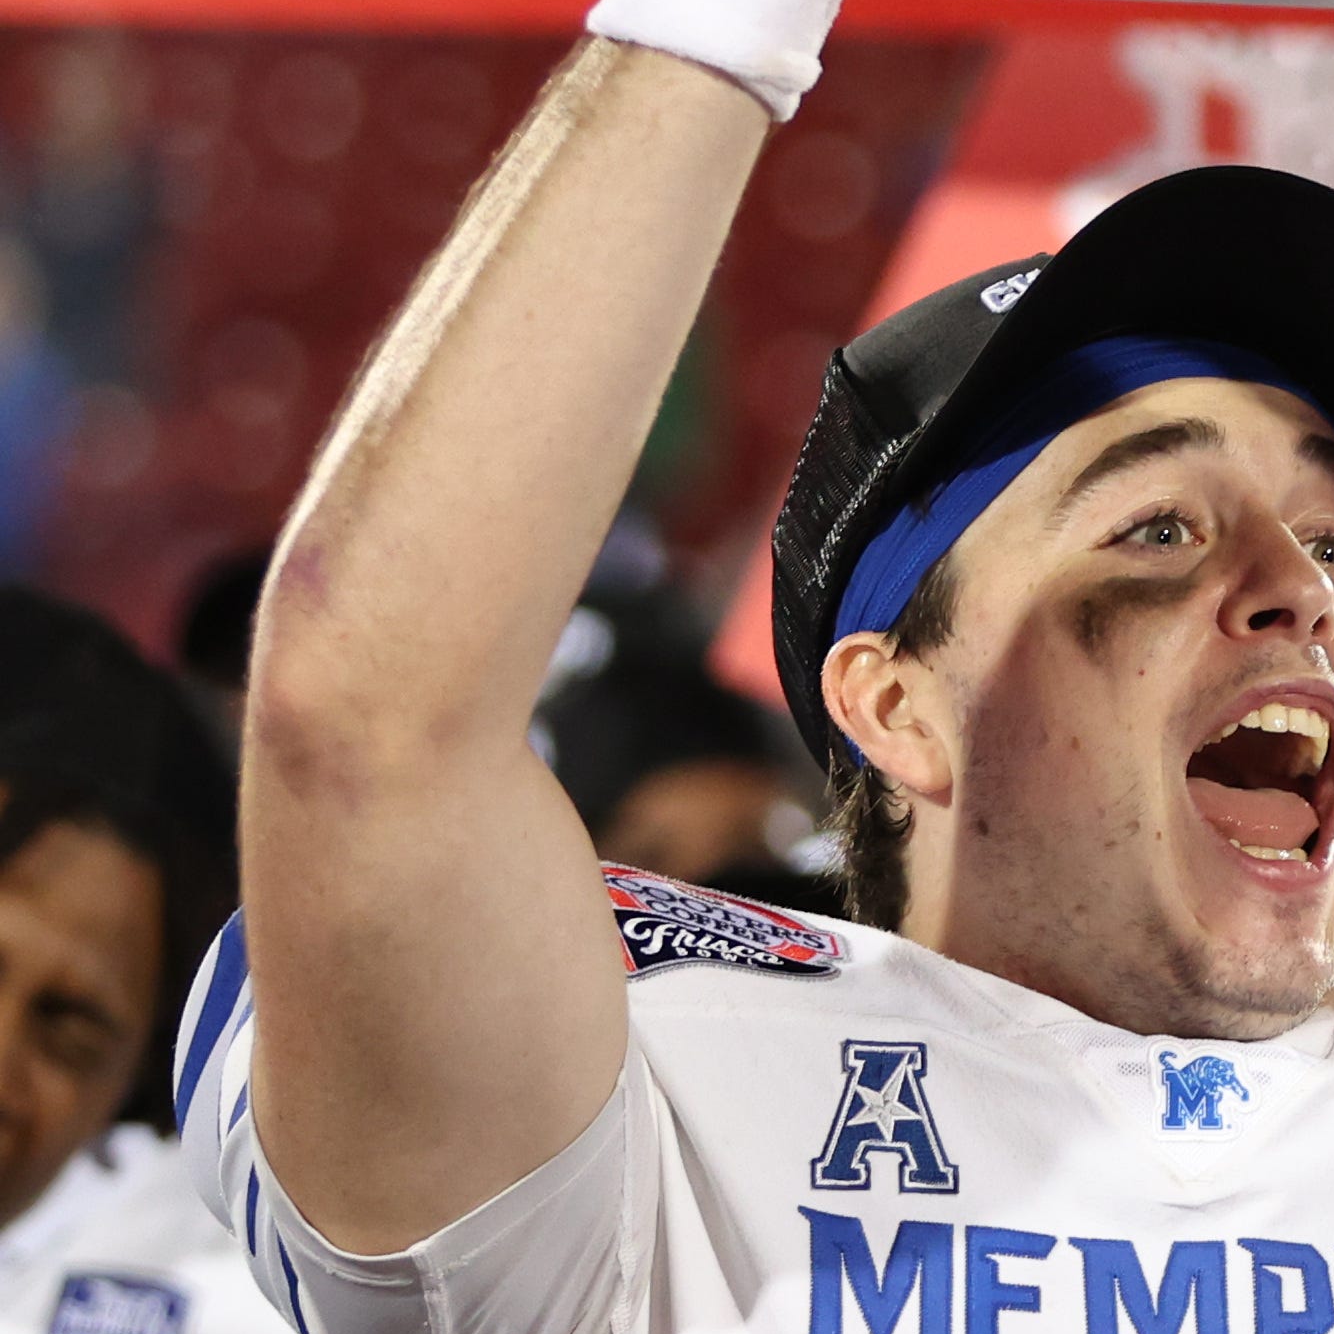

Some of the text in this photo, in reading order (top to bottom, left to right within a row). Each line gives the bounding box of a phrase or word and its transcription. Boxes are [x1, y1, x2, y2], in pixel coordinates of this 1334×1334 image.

[603, 876, 826, 950] COOTER'S
[645, 899, 769, 945] COFFEE
[623, 917, 784, 965] Frisco
